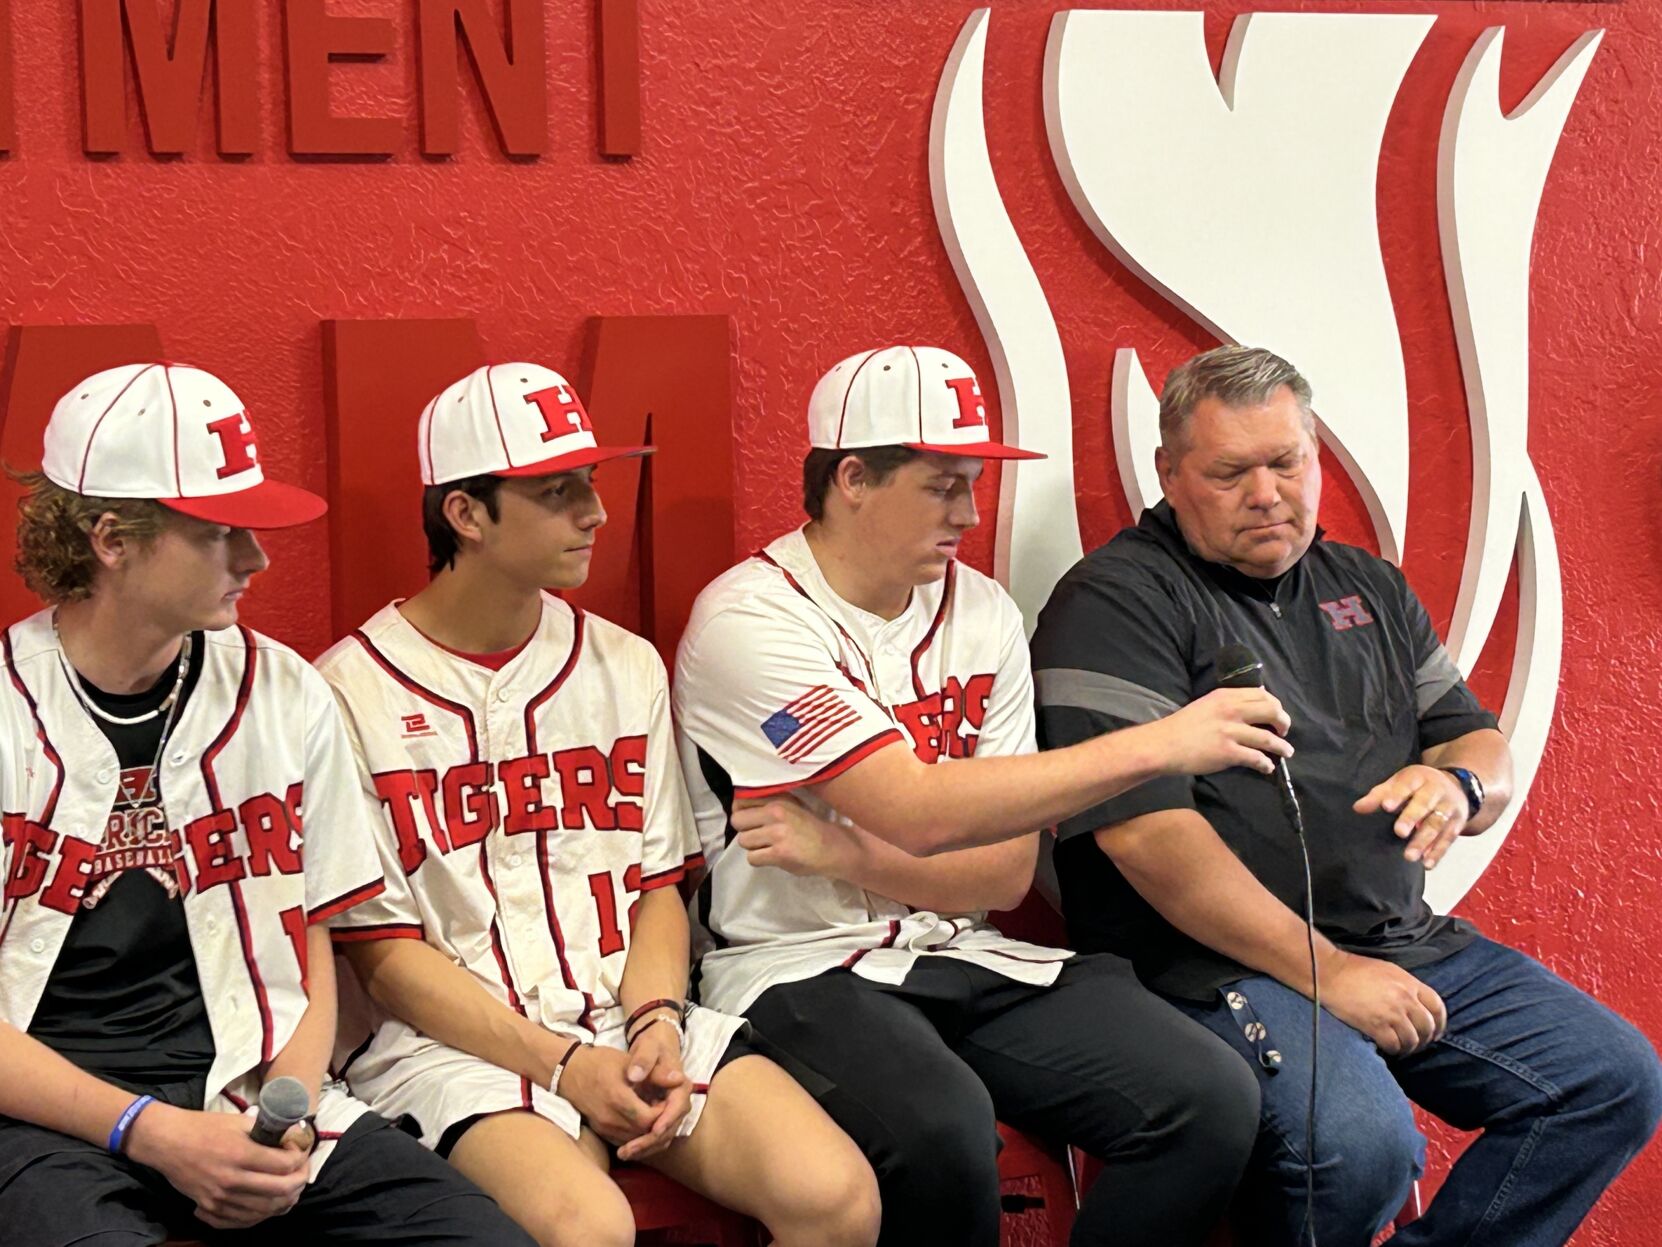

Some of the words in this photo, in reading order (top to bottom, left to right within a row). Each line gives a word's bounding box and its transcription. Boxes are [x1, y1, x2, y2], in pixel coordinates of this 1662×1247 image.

[0, 0, 641, 160] MEN
[1318, 594, 1375, 631] H
[371, 734, 649, 877] TIGERS
